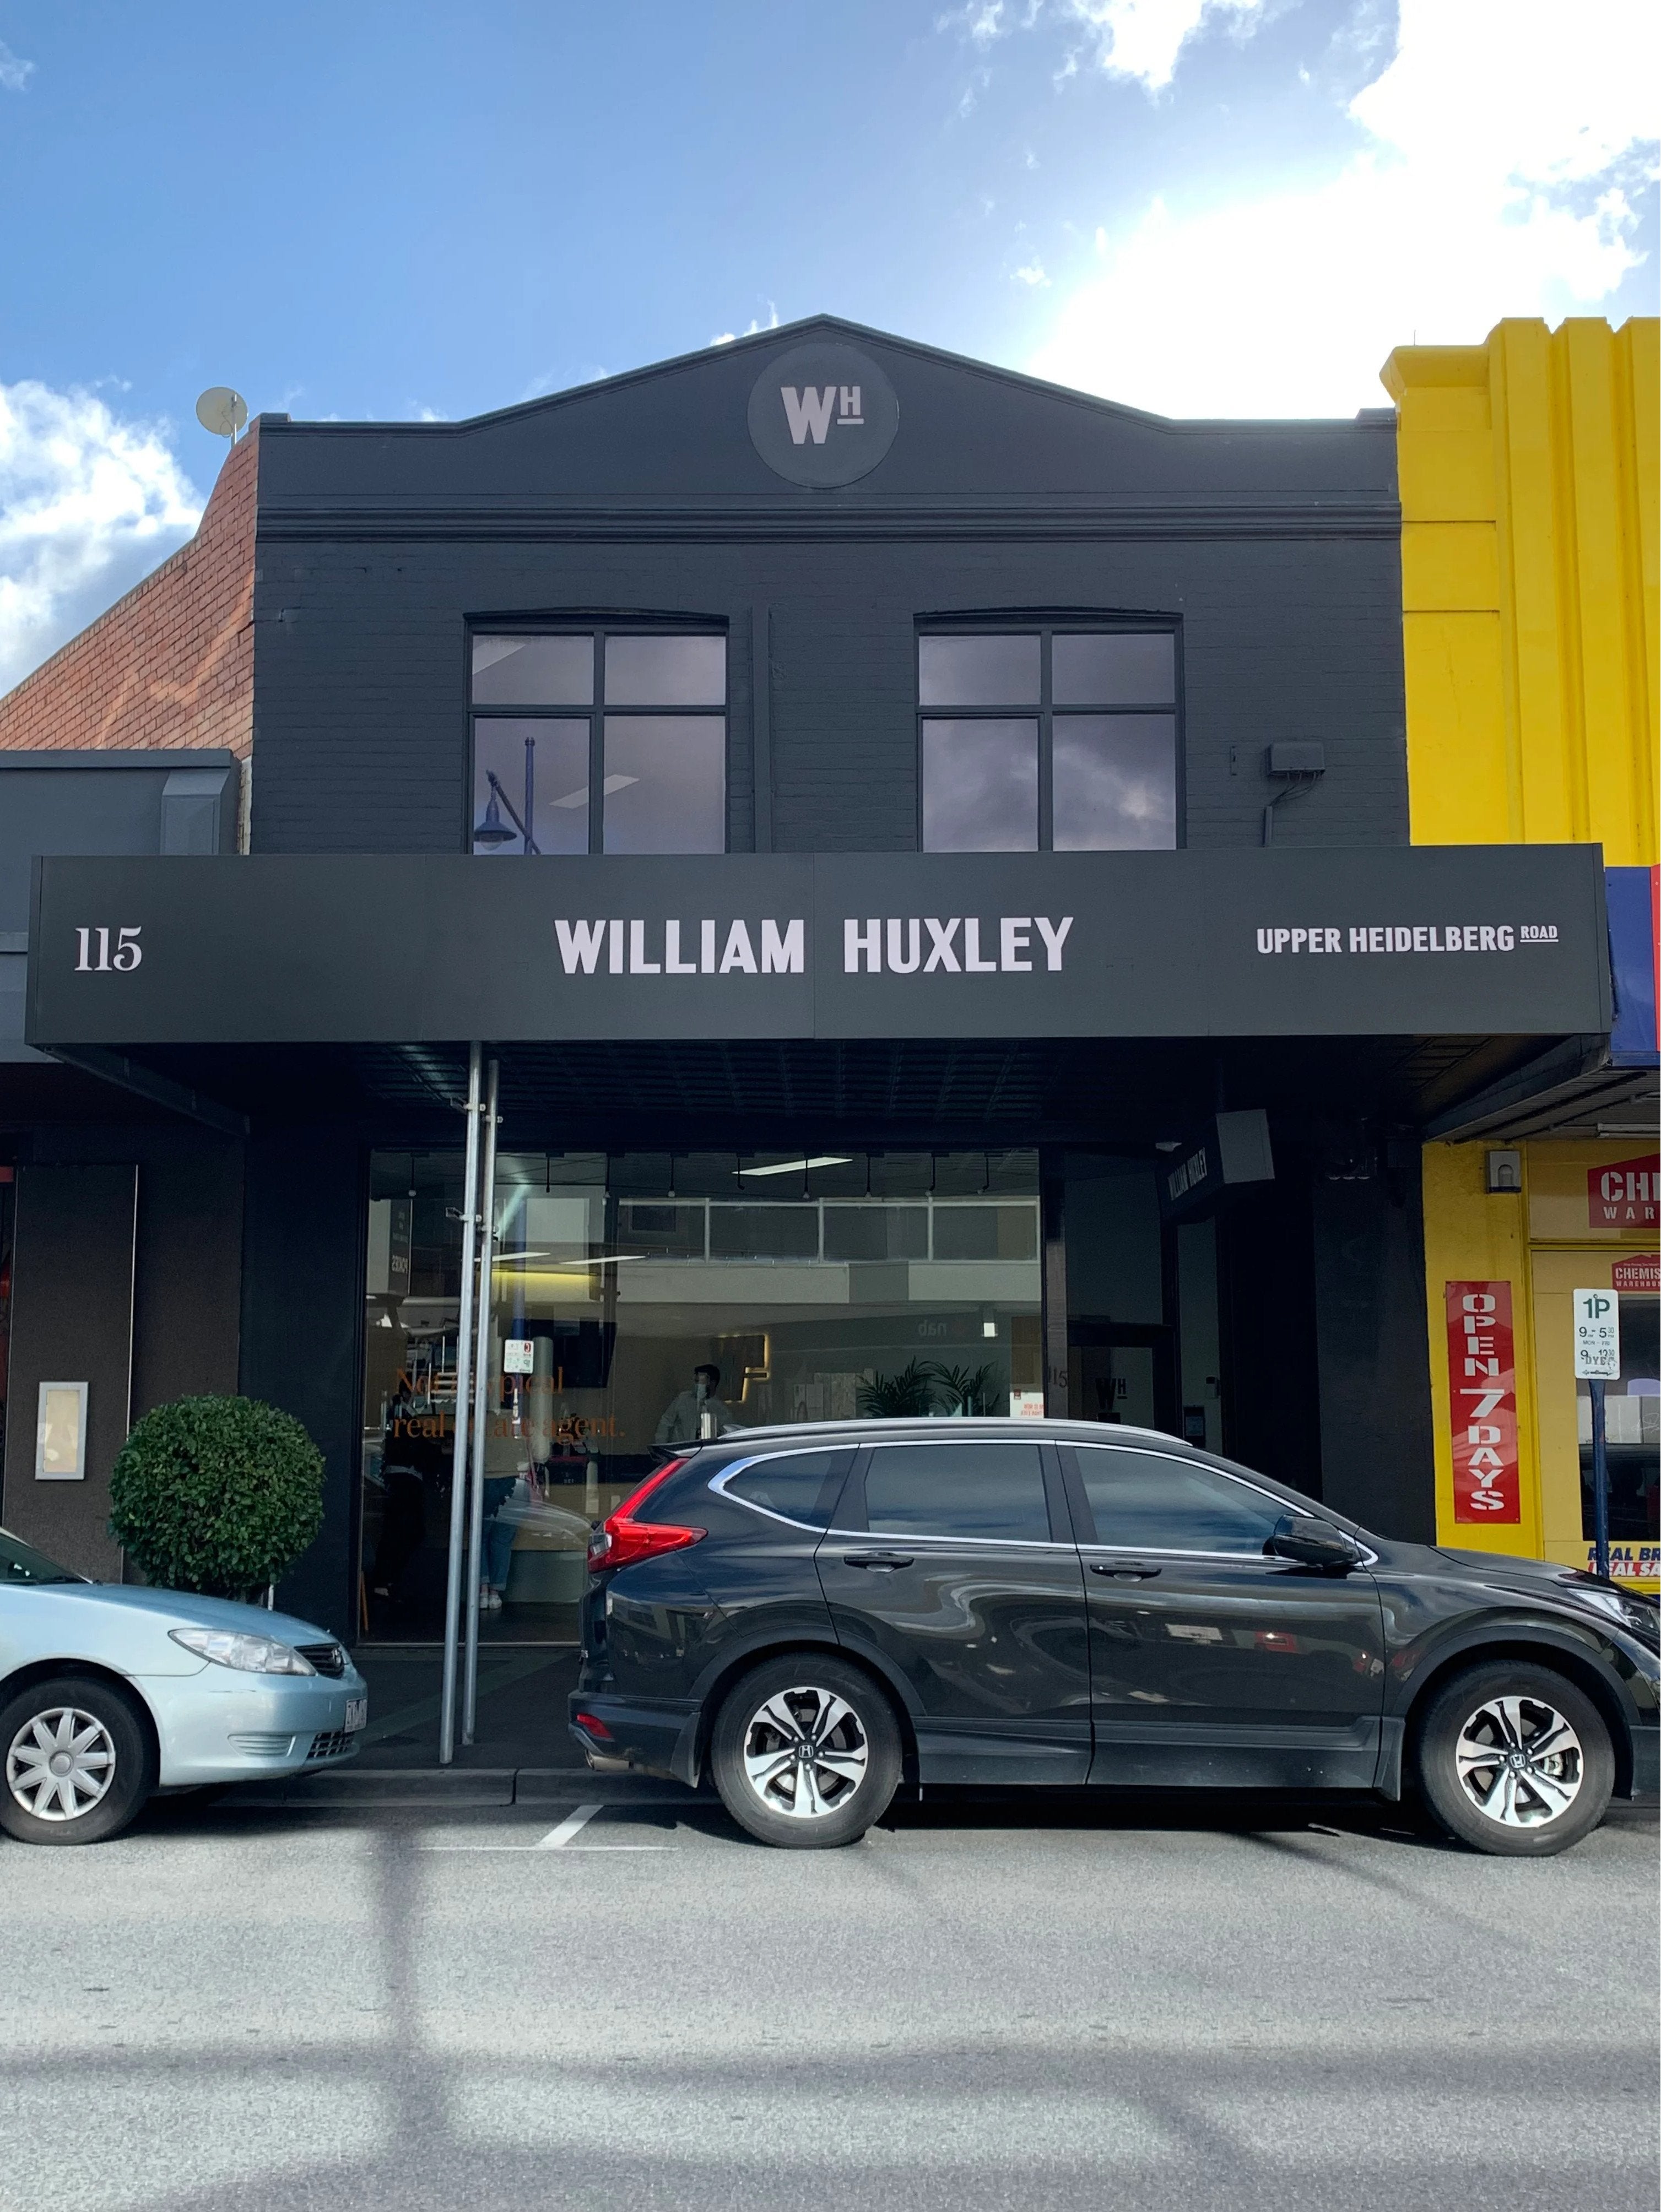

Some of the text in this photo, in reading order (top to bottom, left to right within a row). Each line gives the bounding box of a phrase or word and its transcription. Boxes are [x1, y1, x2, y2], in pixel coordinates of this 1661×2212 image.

[74, 925, 142, 972] 115
[554, 917, 1074, 975] WILLIAM HUXLEY
[1257, 925, 1559, 953] UPPER HEIDELBERG ROAD
[1603, 1207, 1655, 1219] WAR
[1615, 1267, 1660, 1280] CHEMIS
[1583, 1298, 1610, 1319] 1P
[1579, 1326, 1587, 1337] 9
[1599, 1327, 1607, 1338] 5
[1460, 1293, 1505, 1510] OPEN 7 DAYS
[393, 1409, 446, 1438] real
[542, 1413, 626, 1446] agent.
[1587, 1547, 1634, 1561] RAL
[1593, 1562, 1636, 1576] AL
